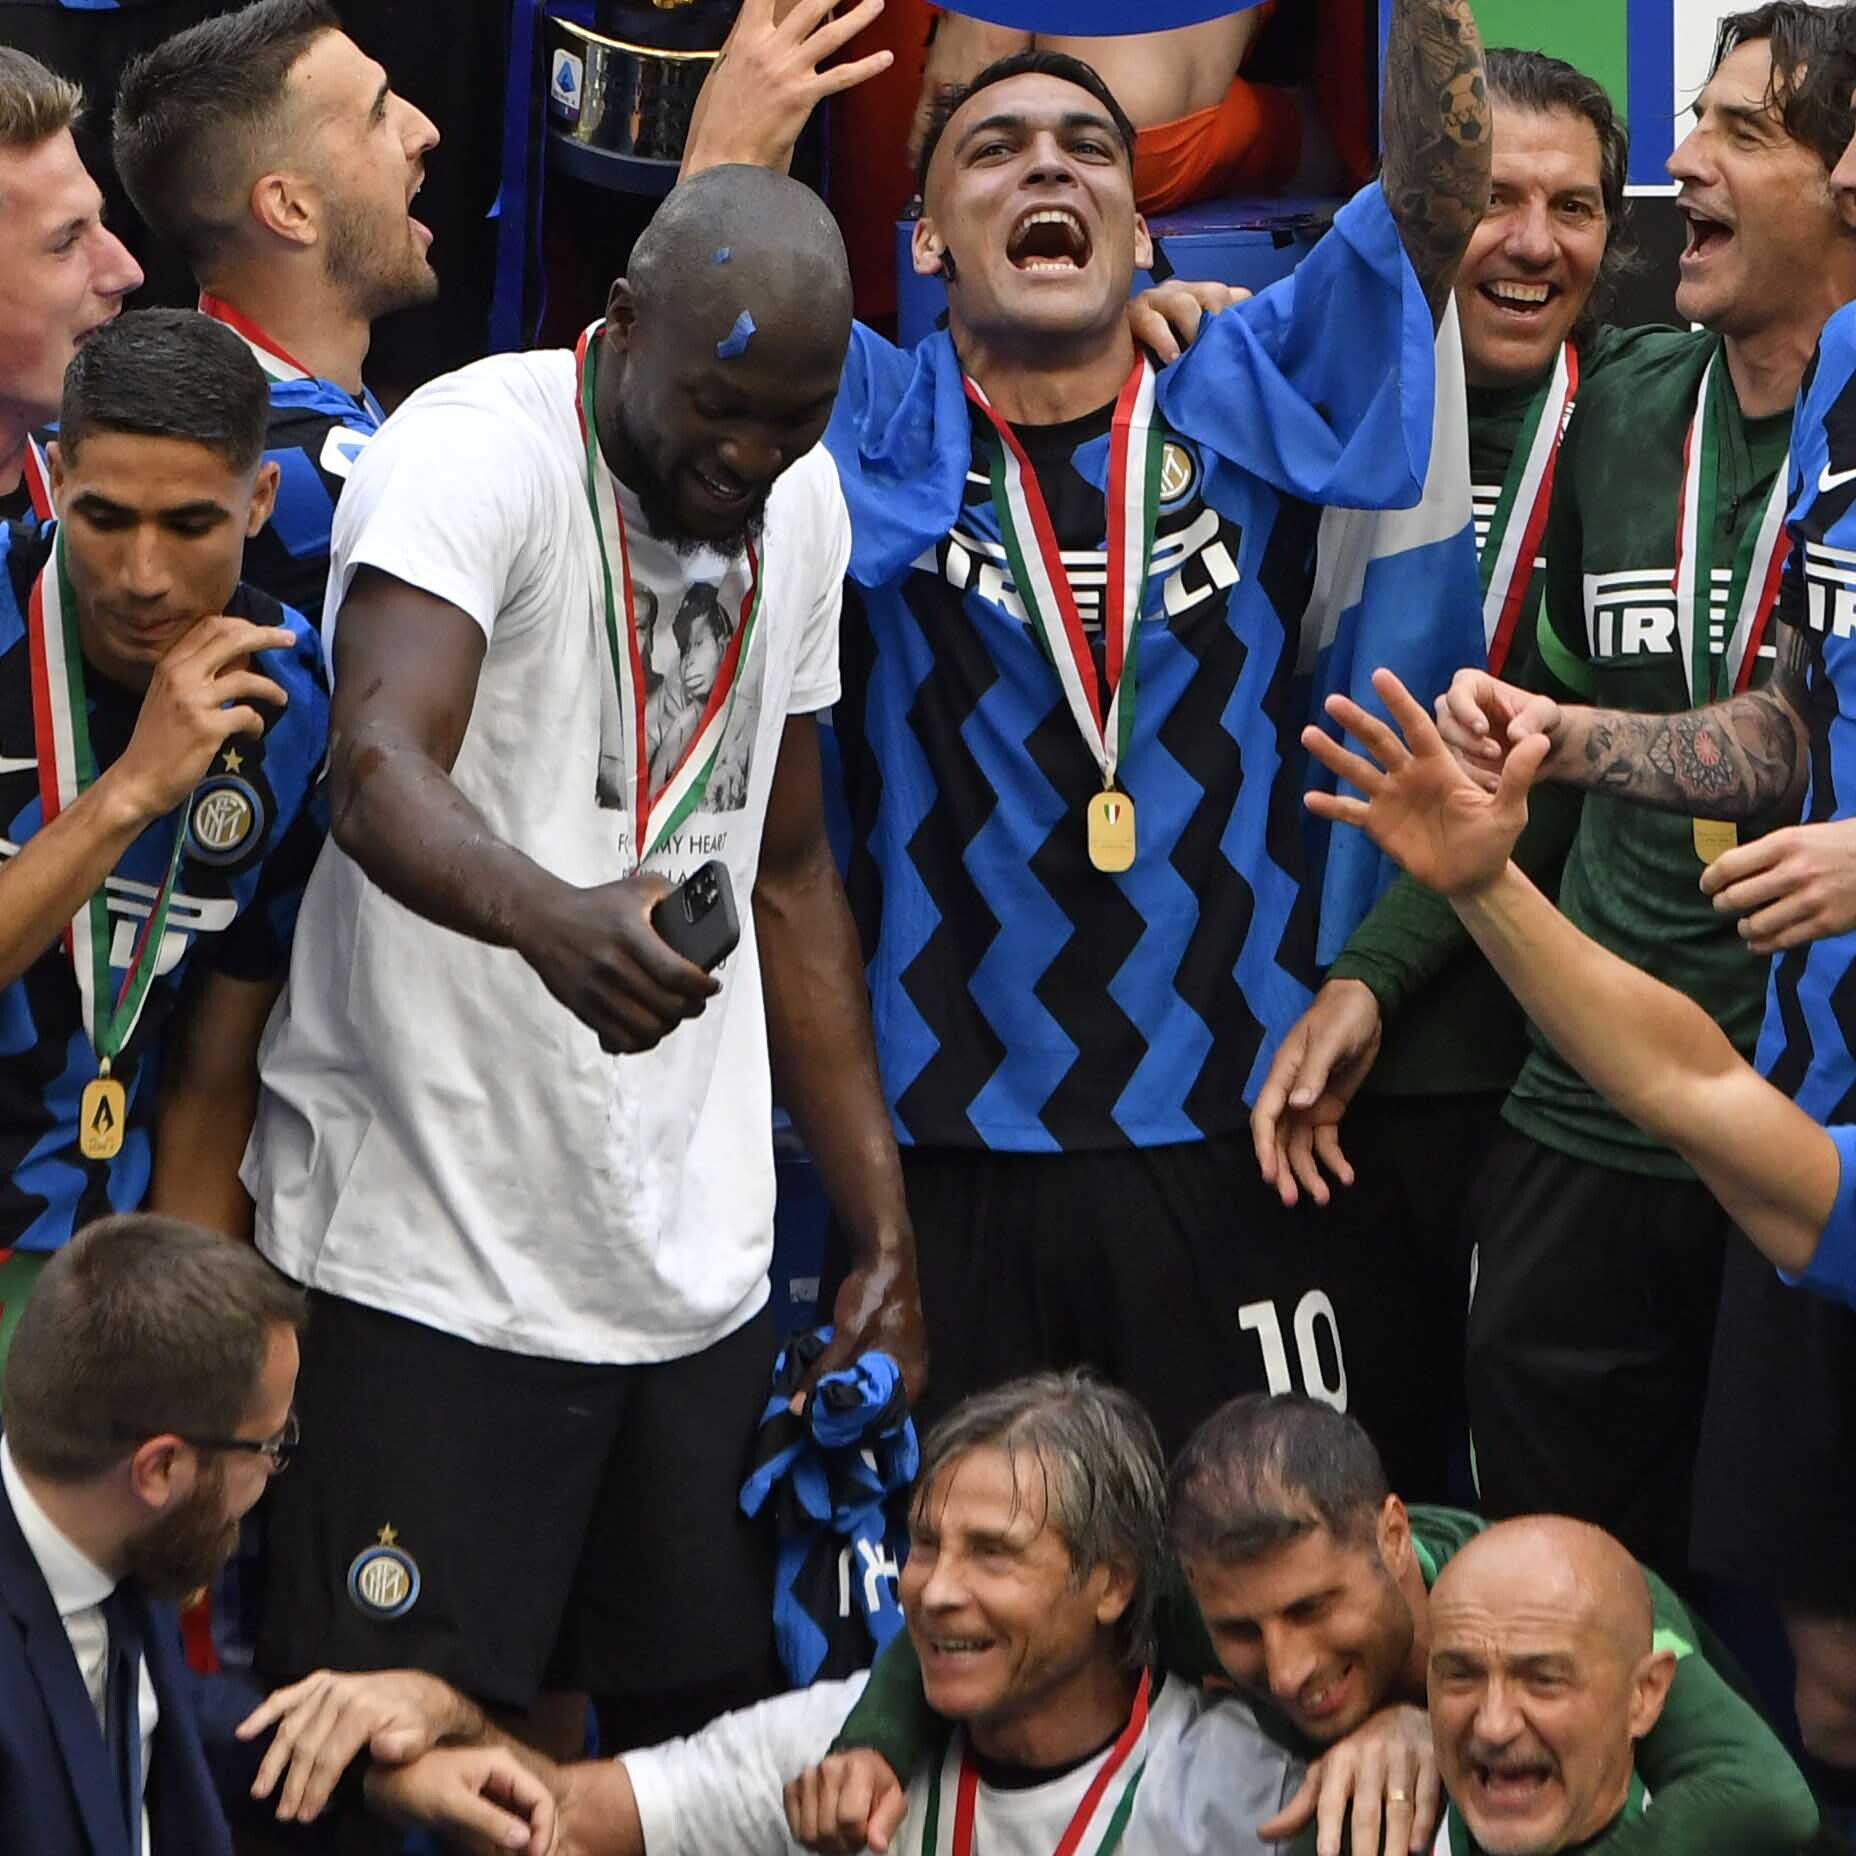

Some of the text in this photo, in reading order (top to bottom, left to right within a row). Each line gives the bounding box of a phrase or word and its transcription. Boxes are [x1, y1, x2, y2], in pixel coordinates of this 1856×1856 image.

[655, 835, 684, 855] MY
[689, 831, 728, 855] HEART
[1237, 1288, 1348, 1415] 10
